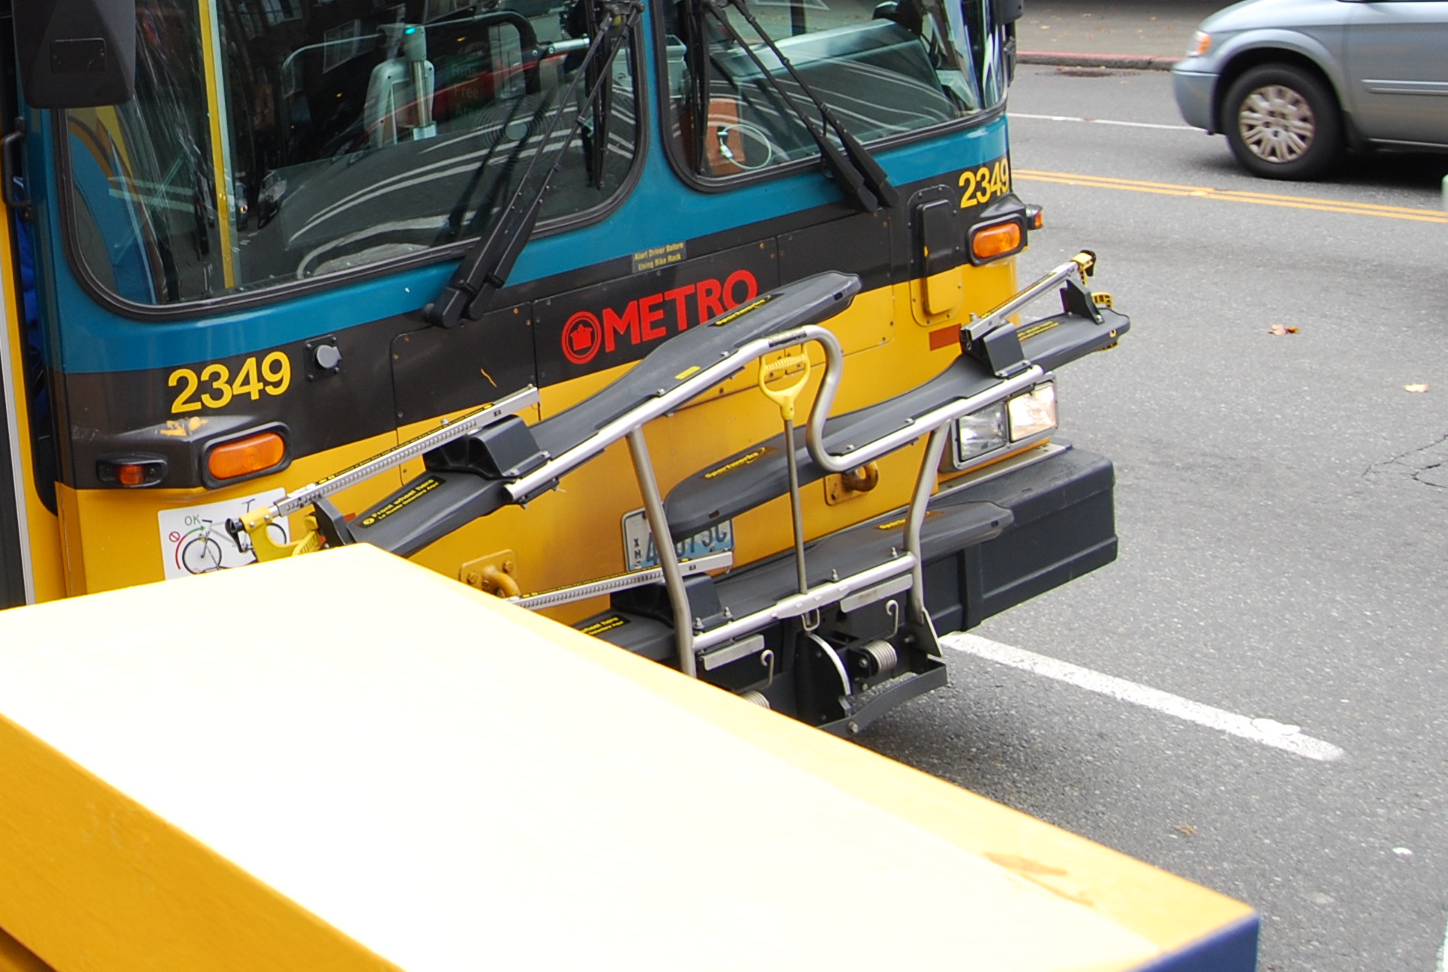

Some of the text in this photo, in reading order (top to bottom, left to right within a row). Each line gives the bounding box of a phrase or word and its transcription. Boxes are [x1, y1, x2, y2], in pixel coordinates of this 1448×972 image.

[958, 158, 1010, 209] 2349
[635, 242, 683, 260] Alert Driver Before
[638, 252, 681, 271] Using Bike Rack
[602, 269, 758, 353] METRO
[168, 351, 291, 414] 2349
[393, 490, 416, 505] wheel
[415, 479, 434, 491] here
[184, 515, 201, 526] OK
